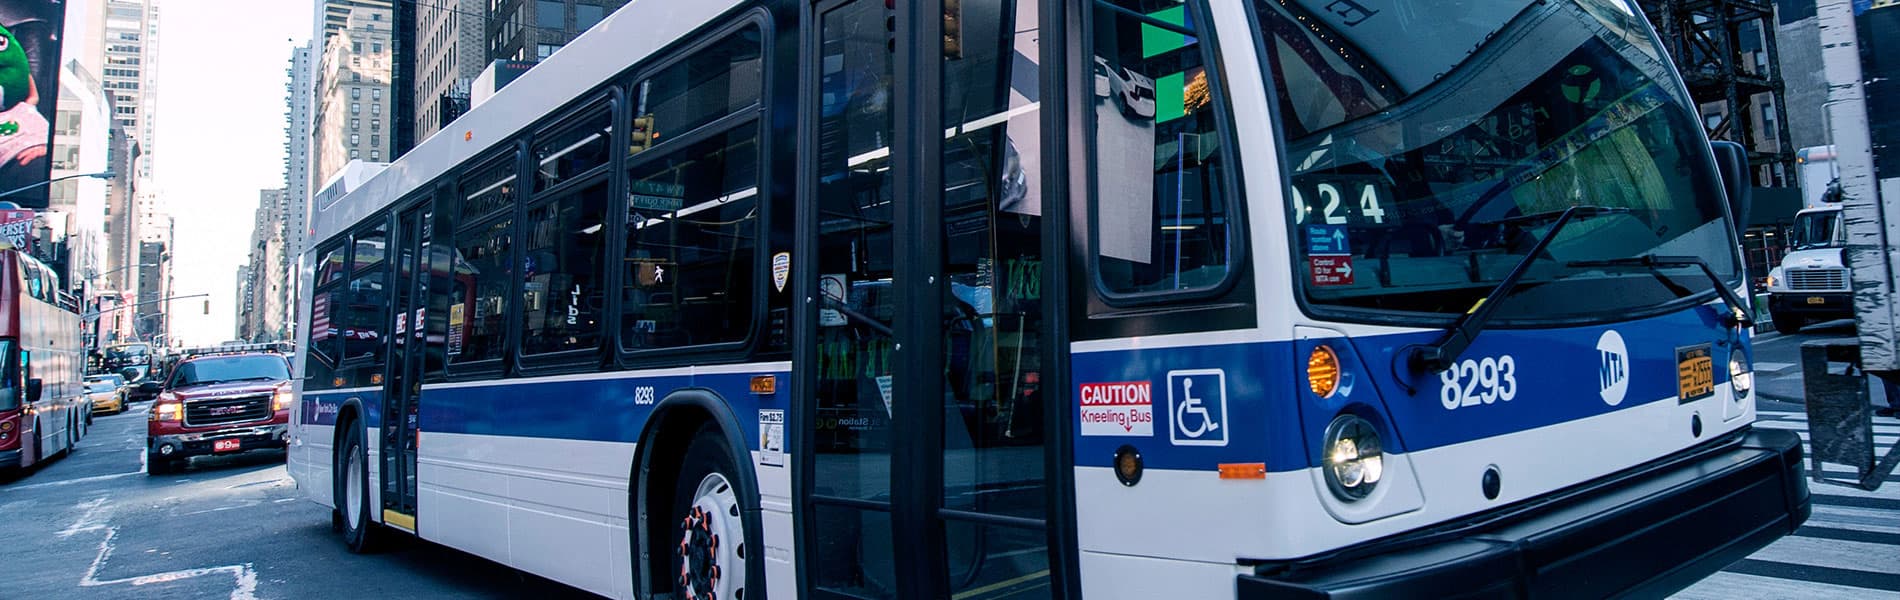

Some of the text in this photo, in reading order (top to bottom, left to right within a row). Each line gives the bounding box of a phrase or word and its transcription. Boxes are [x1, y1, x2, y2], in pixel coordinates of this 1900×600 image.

[1599, 350, 1625, 390] MTA
[1440, 355, 1517, 410] 8293
[634, 386, 655, 405] 8293
[1081, 384, 1150, 404] CAUTION
[1081, 409, 1151, 425] Kneeling Bus
